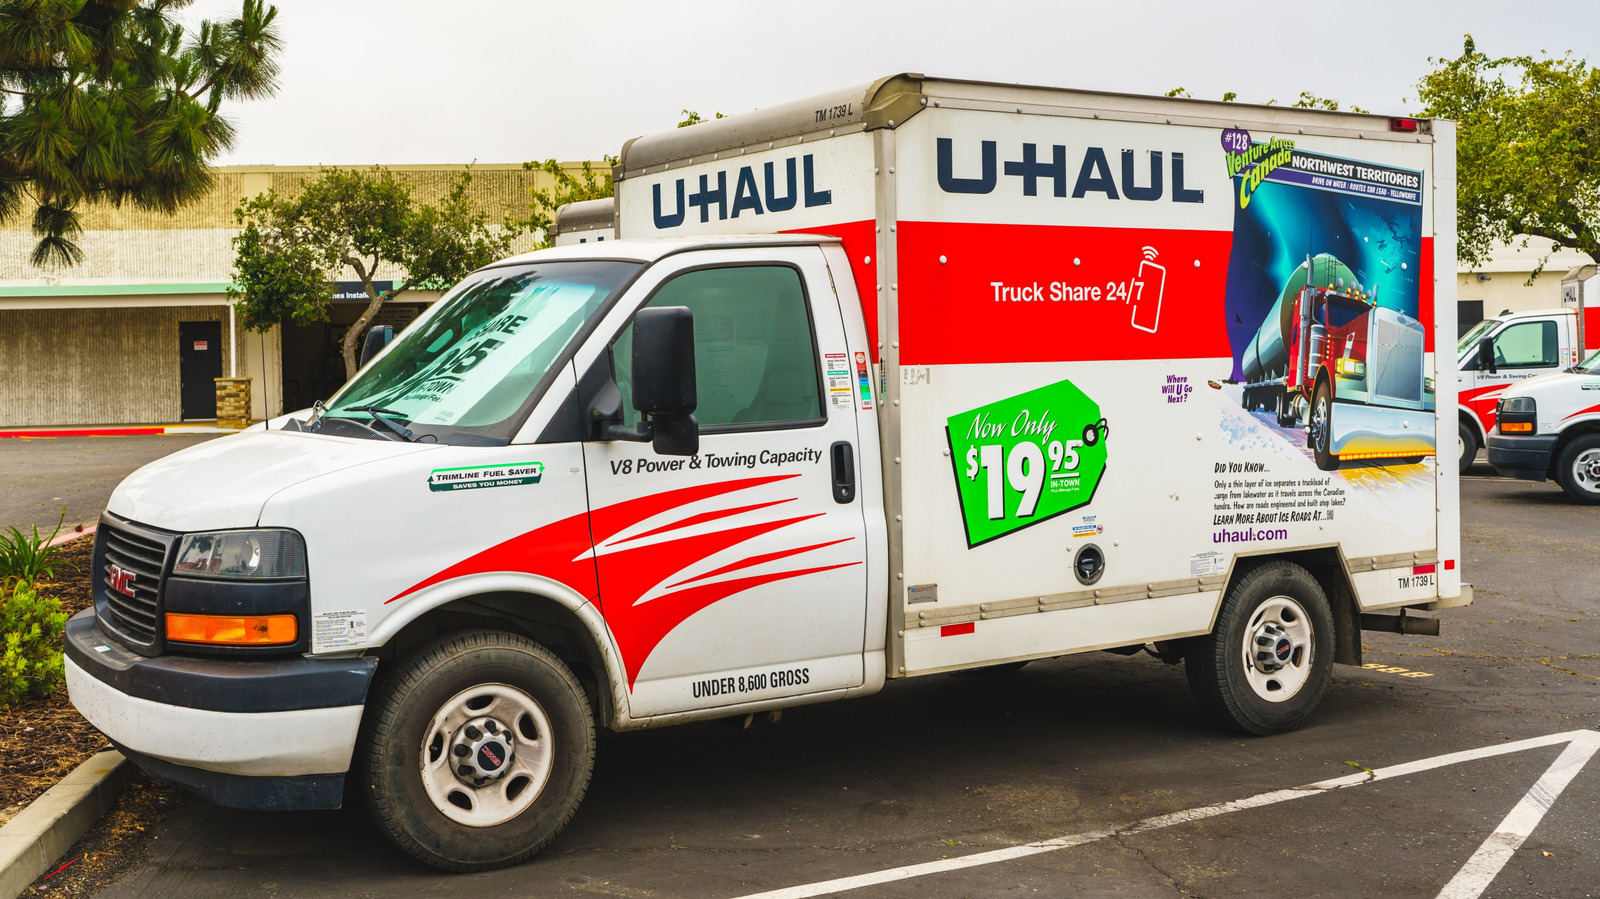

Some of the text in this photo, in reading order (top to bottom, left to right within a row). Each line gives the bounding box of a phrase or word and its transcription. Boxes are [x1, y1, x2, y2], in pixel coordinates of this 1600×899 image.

[815, 103, 852, 123] TM 1739 L
[1225, 132, 1249, 151] #128
[1226, 135, 1296, 179] Venture Across
[936, 137, 1204, 204] U-HAUL
[1240, 147, 1293, 209] Canada
[1292, 155, 1419, 188] NORTHWEST TERRITORIES
[652, 153, 832, 229] U-HAUL
[1311, 176, 1325, 186] DRIVE
[1325, 179, 1333, 187] ON
[1333, 180, 1347, 189] WATER
[1349, 182, 1366, 193] ROUTES
[1367, 185, 1376, 194] SUR
[1390, 189, 1417, 201] YELLOWKNIFE
[990, 277, 1145, 305] Truck Share 24/7
[1166, 375, 1188, 384] Where
[1161, 384, 1193, 396] Will U Go
[1167, 393, 1188, 404] Next?
[966, 409, 1059, 446] Now Only
[610, 447, 823, 475] V8 Power & Towing Capacity
[1048, 439, 1081, 472] 95
[436, 472, 480, 481] TRIMLINE
[483, 470, 505, 478] FUEL
[1214, 461, 1270, 473] DID YOU KNOW...
[1051, 479, 1080, 488] IN-TOWN
[1214, 480, 1227, 490] Only
[1233, 480, 1243, 488] thin
[1244, 480, 1257, 489] layer
[1258, 479, 1265, 487] of
[1273, 480, 1296, 488] separates
[1302, 478, 1324, 486] truckload
[1324, 477, 1331, 486] of
[1229, 490, 1242, 499] from
[1242, 490, 1267, 498] lakewater
[1275, 489, 1280, 497] it
[1280, 489, 1297, 497] travels
[1314, 488, 1322, 496] the
[1322, 488, 1346, 497] Canadian
[1213, 501, 1231, 511] tundra.
[1233, 501, 1245, 509] How
[1255, 500, 1270, 509] roads
[1270, 500, 1296, 510] engineered
[1297, 499, 1306, 507] and
[1306, 499, 1319, 507] built
[1319, 500, 1330, 508] atop
[1330, 498, 1346, 506] lakes?
[1213, 514, 1235, 525] LEARN
[1235, 512, 1254, 524] MORE
[1255, 511, 1278, 523] ABOUT
[1278, 510, 1290, 522] ICE
[1290, 510, 1313, 521] ROADS
[1213, 527, 1287, 543] uhaul.com
[109, 564, 136, 598] GMC
[1398, 574, 1435, 589] TM 1739 L
[692, 668, 810, 699] UNDER 8,600 GROSS
